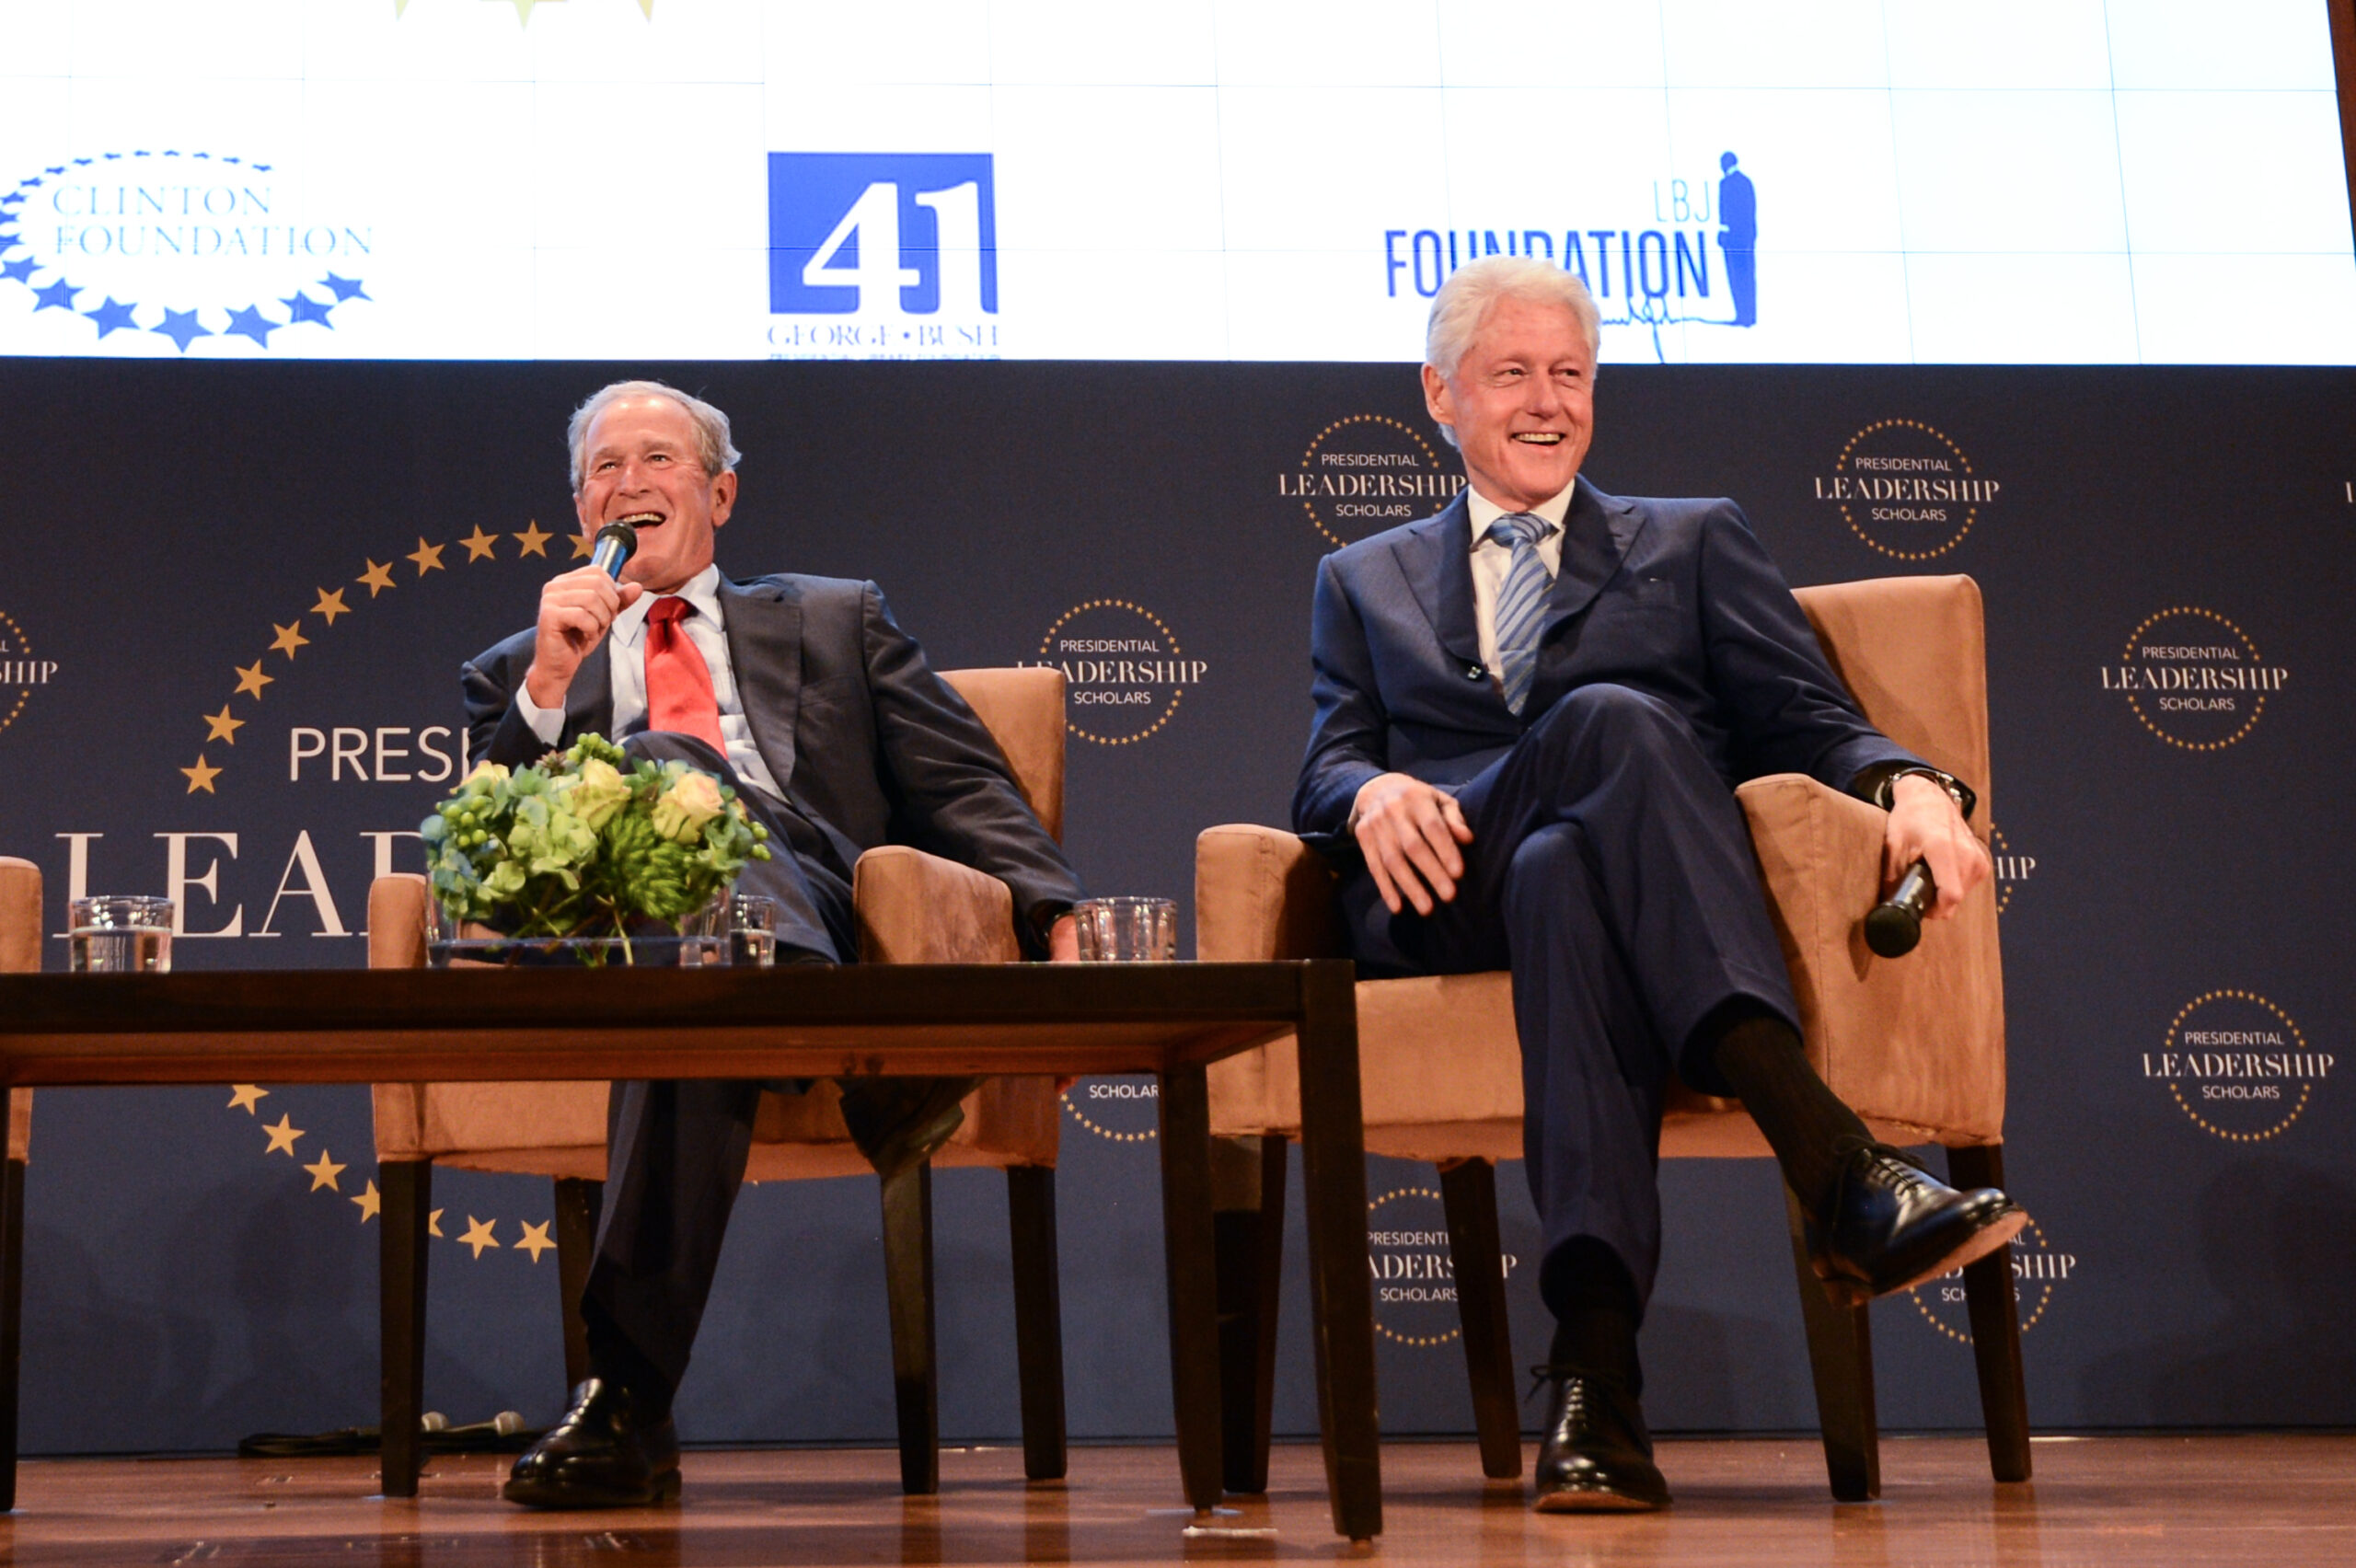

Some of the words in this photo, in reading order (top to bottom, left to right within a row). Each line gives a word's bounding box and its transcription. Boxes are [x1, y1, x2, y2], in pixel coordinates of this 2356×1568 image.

[52, 186, 271, 215] CLINTON
[1654, 180, 1711, 223] LBJ
[55, 225, 373, 256] FOUNDATION
[803, 181, 983, 314] 41
[1322, 454, 1419, 467] PRESIDENTIAL
[1855, 457, 1952, 472] PRESIDENTIAL
[1279, 474, 1467, 497] LEADERSHIP
[1815, 477, 2000, 502] LEADERSHIP
[1335, 504, 1412, 516] SCHOLARS
[1872, 508, 1947, 522] SCHOLARS
[1060, 640, 1161, 653] PRESIDENTIAL
[2142, 646, 2240, 660] PRESIDENTIAL
[0, 661, 59, 684] HIP
[1016, 661, 1207, 684] ADERSHIP
[2102, 666, 2288, 691] LEADERSHIP
[1074, 691, 1151, 705] SCHOLARS
[2159, 698, 2235, 711] SCHOLARS
[2184, 1032, 2285, 1045] PRESIDENTIAL
[2142, 1053, 2335, 1078] LEADERSHIP
[2201, 1085, 2281, 1100] SCHOLARS
[1380, 1288, 1458, 1302] SCHOLARS
